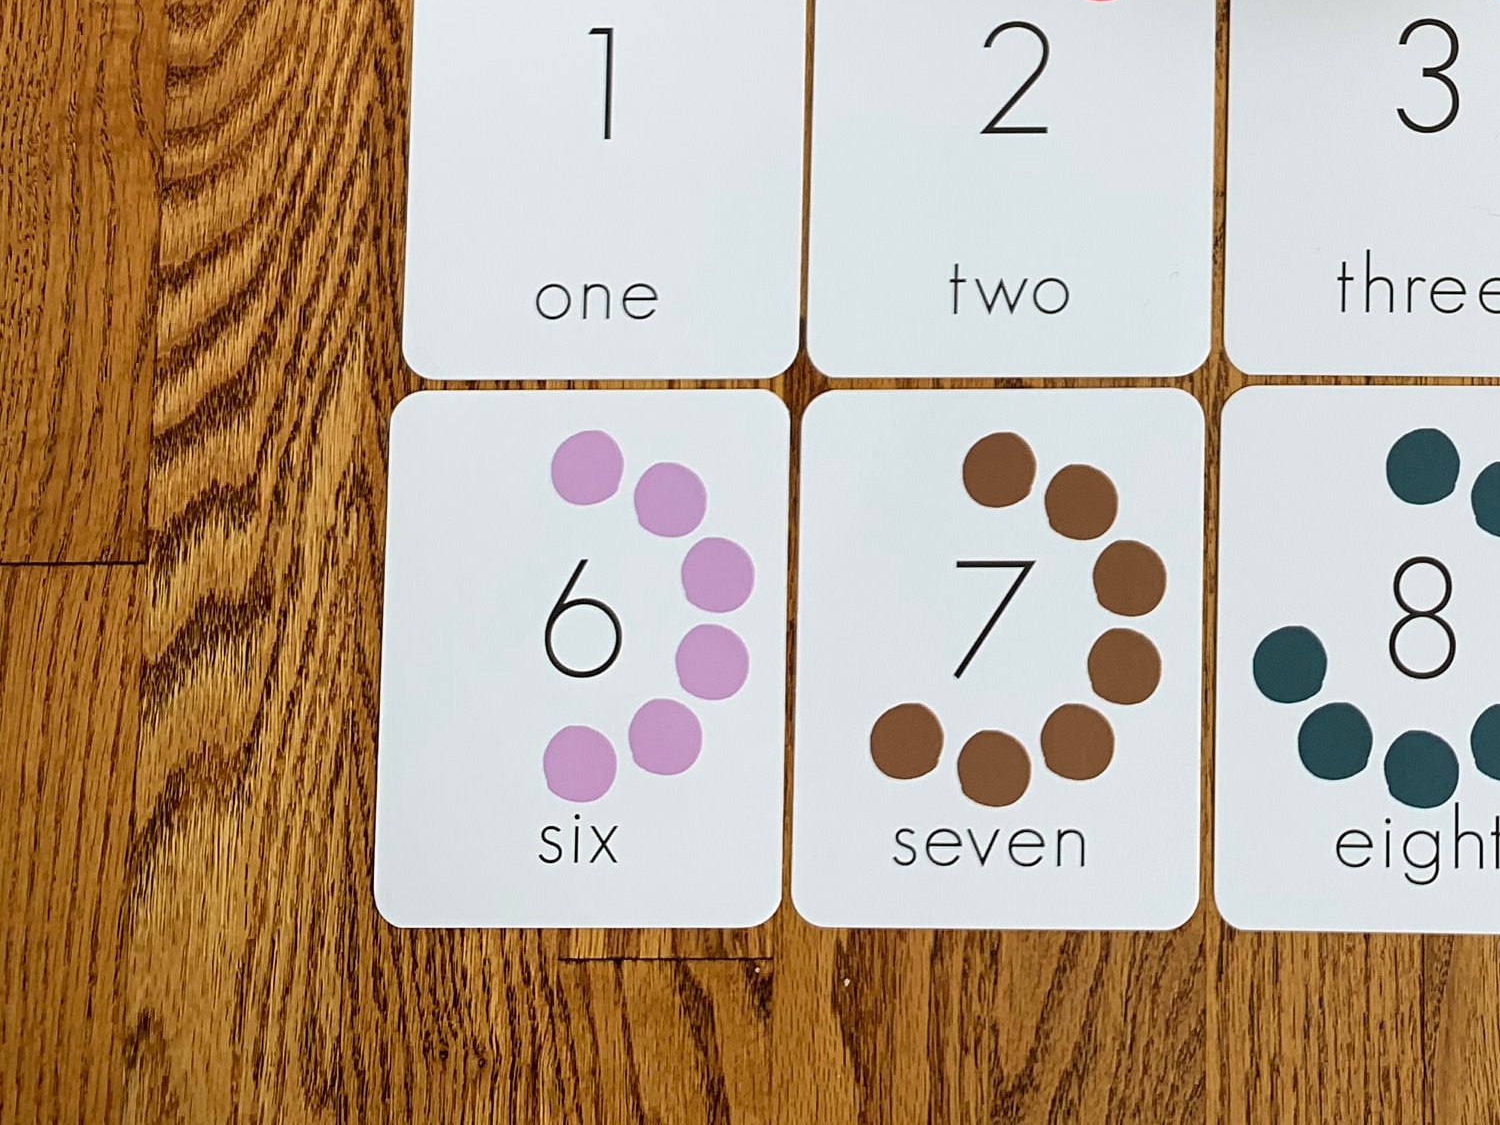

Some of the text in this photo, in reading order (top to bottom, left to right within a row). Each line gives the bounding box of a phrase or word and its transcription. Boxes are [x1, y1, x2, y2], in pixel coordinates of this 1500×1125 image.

[588, 27, 614, 140] 1
[980, 20, 1050, 135] 2
[1396, 18, 1460, 134] 3
[535, 283, 658, 320] one
[949, 263, 1070, 315] two
[544, 558, 622, 679] 6
[953, 560, 1036, 679] 7
[1388, 556, 1457, 680] 8
[538, 813, 618, 864] six
[892, 828, 1085, 868] seven
